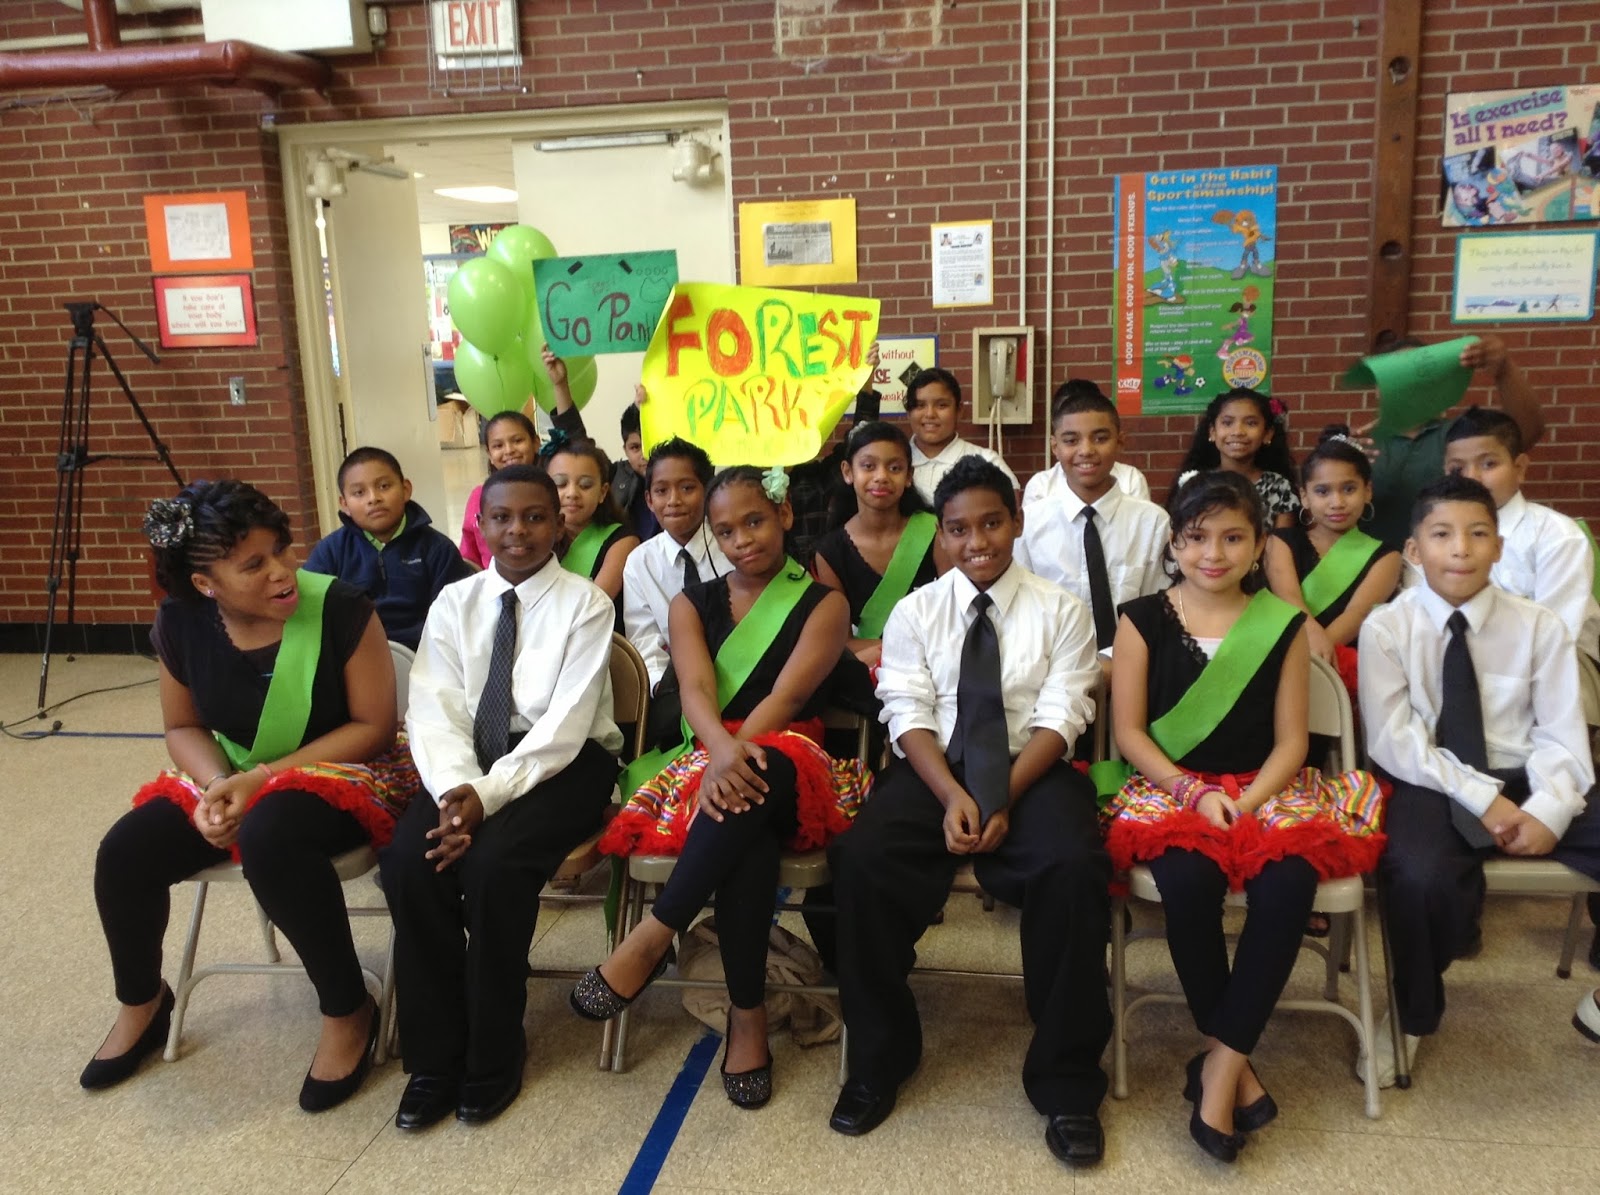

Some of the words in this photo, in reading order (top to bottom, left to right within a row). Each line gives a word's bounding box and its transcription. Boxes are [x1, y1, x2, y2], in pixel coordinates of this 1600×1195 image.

[448, 0, 500, 46] EXIT
[1450, 112, 1471, 129] Is
[1475, 89, 1563, 123] exercise
[1454, 126, 1481, 145] all
[1486, 124, 1497, 141] I
[1501, 111, 1568, 139] need?
[1147, 184, 1274, 201] Sportsmanship!
[1150, 175, 1176, 185] Get
[1181, 174, 1196, 183] in
[1201, 171, 1226, 181] the
[1231, 168, 1272, 181] Habit
[546, 281, 591, 346] Go
[665, 294, 872, 378] FOREST
[881, 349, 914, 359] without
[683, 374, 808, 438] PARK
